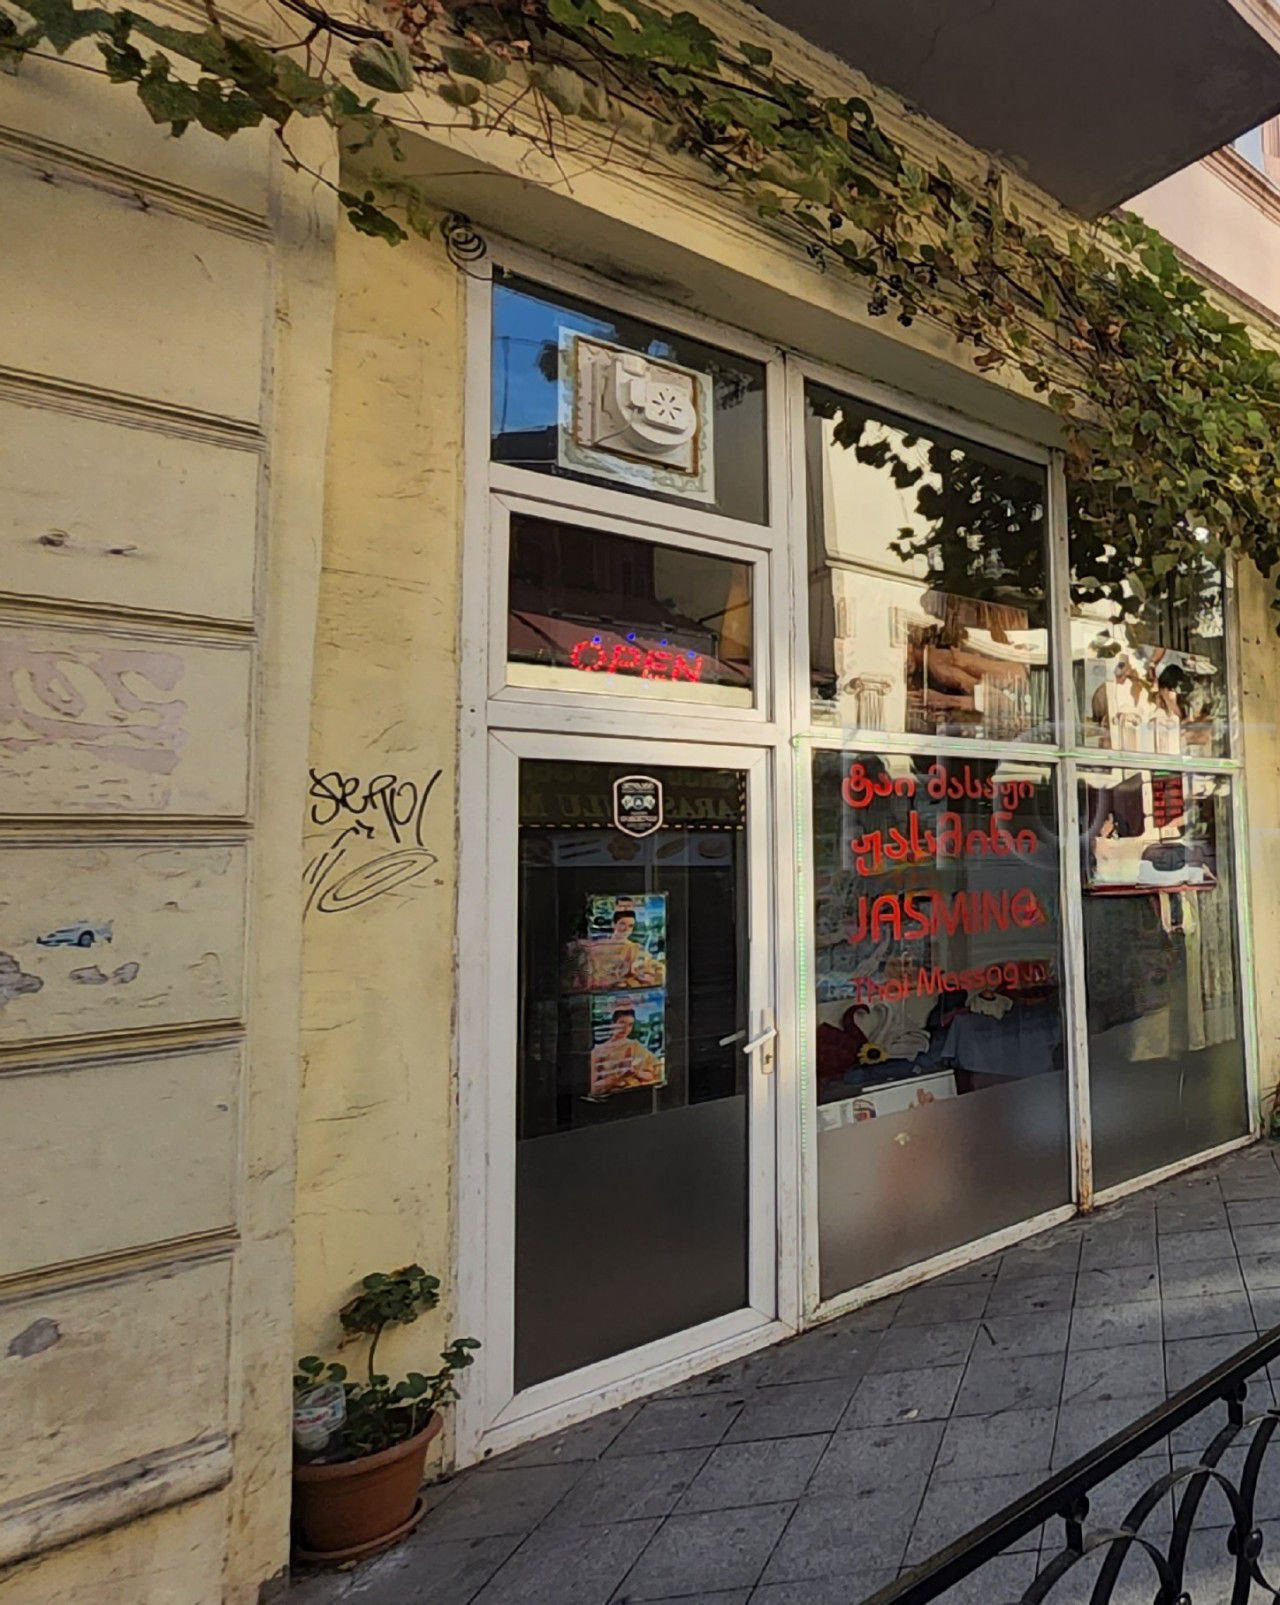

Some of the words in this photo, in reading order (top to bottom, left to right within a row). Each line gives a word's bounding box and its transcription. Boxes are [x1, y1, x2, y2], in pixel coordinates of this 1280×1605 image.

[570, 640, 704, 683] OPEN
[841, 763, 915, 808] ტაი
[928, 763, 1035, 810] მასაჟი
[851, 810, 1038, 875] ჟასმინი
